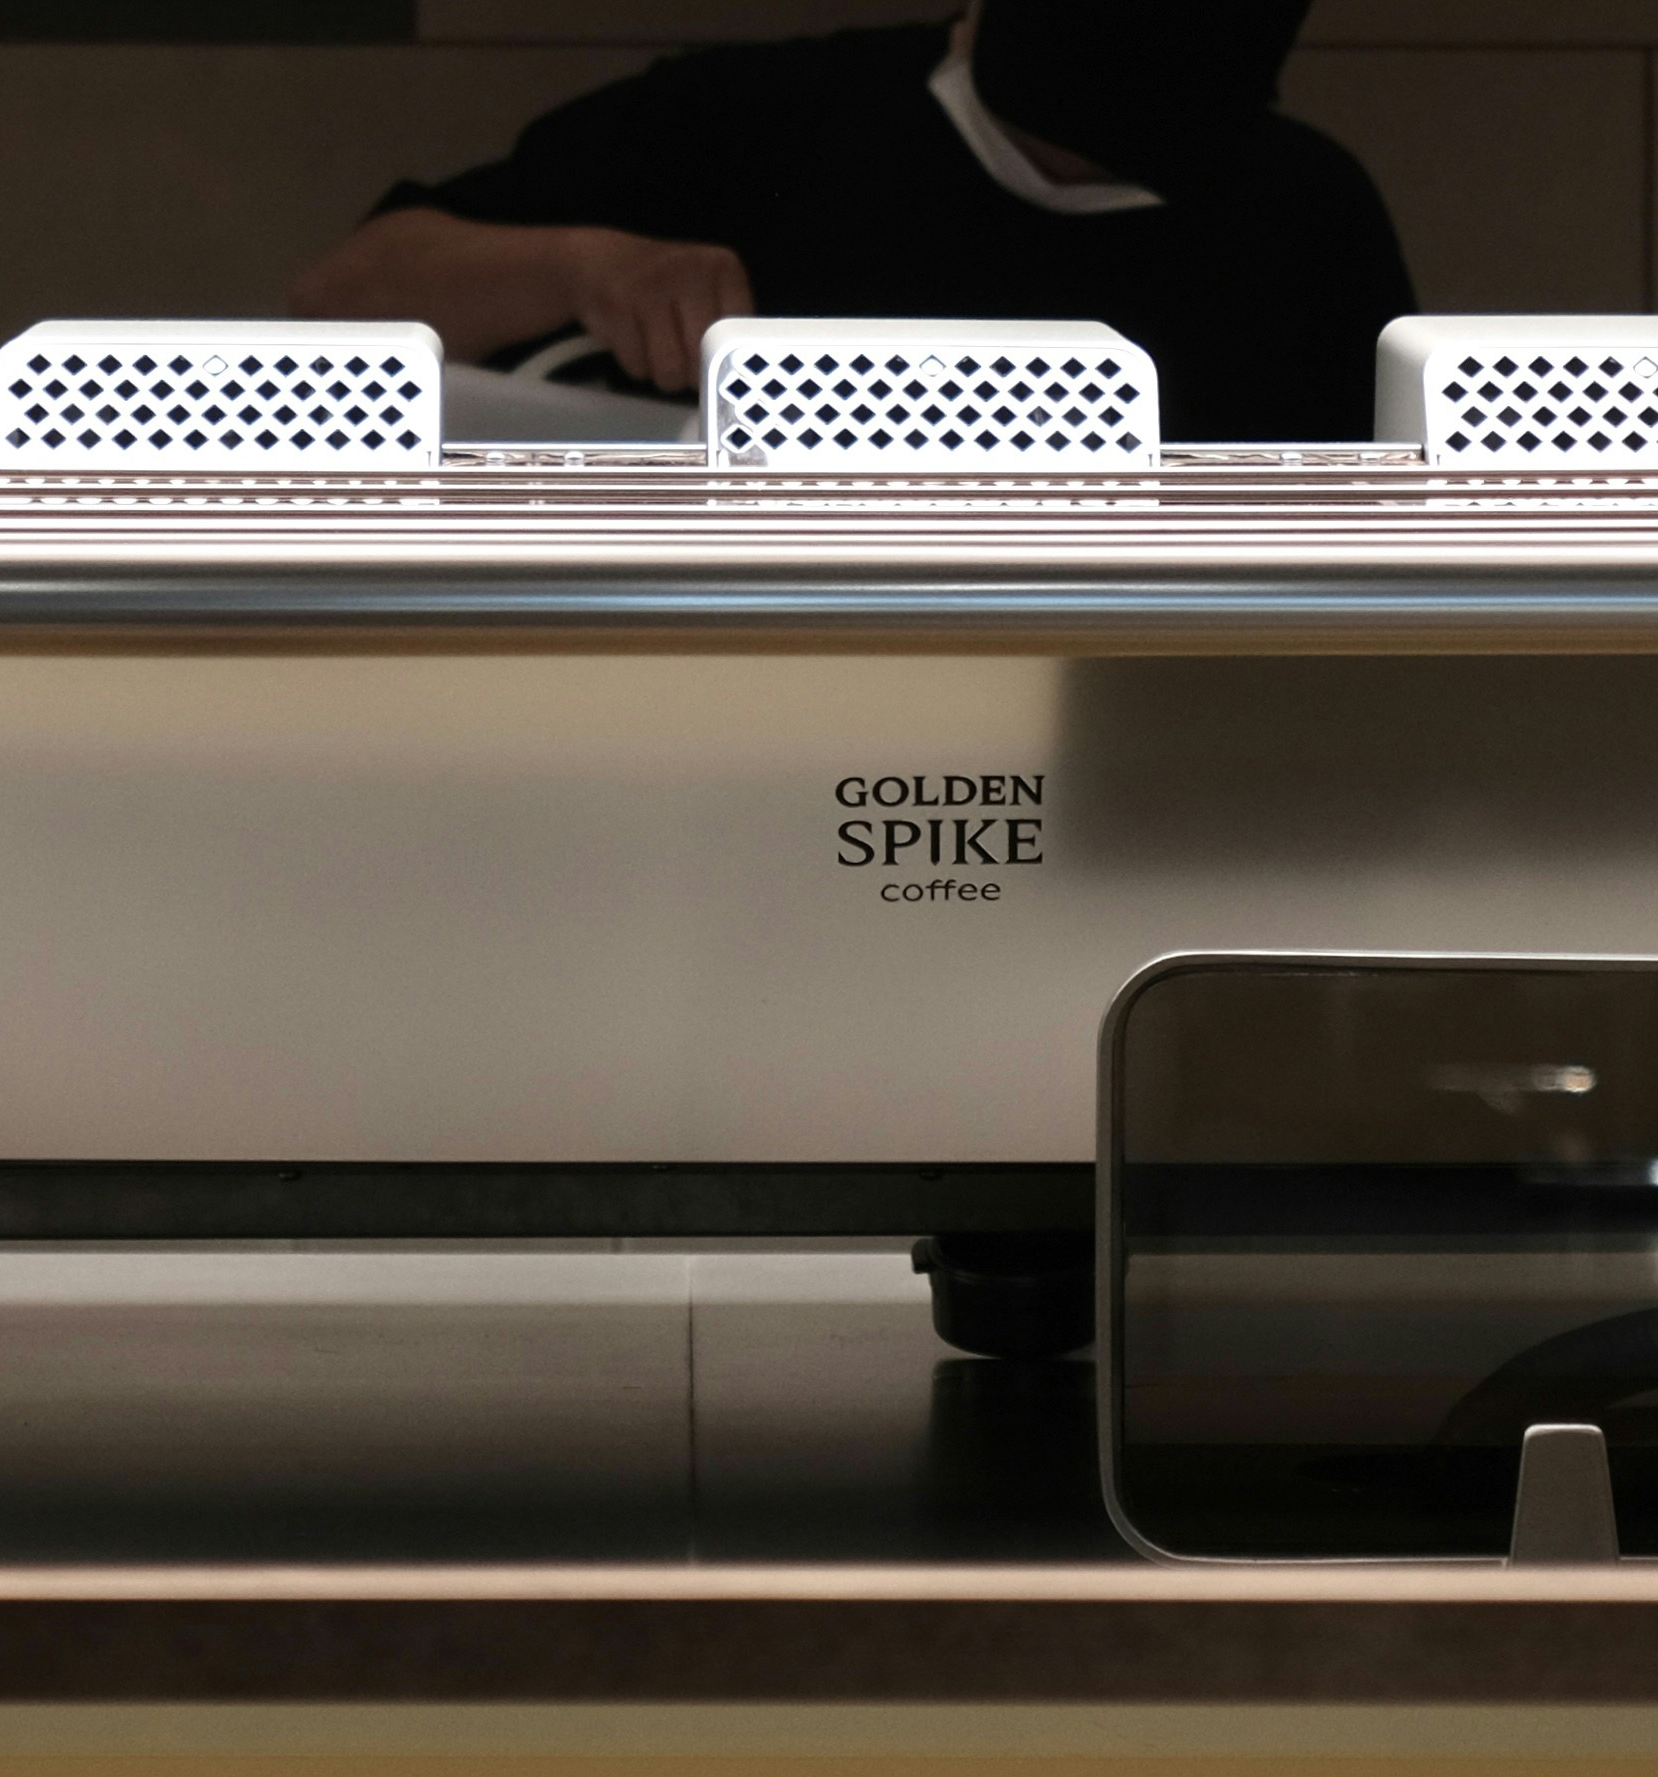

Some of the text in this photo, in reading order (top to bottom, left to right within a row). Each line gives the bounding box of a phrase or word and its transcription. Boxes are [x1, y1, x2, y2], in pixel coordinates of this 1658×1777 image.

[835, 775, 1045, 808] GOLDEN
[837, 819, 1043, 867] SPIKE
[880, 879, 1001, 902] coffee
